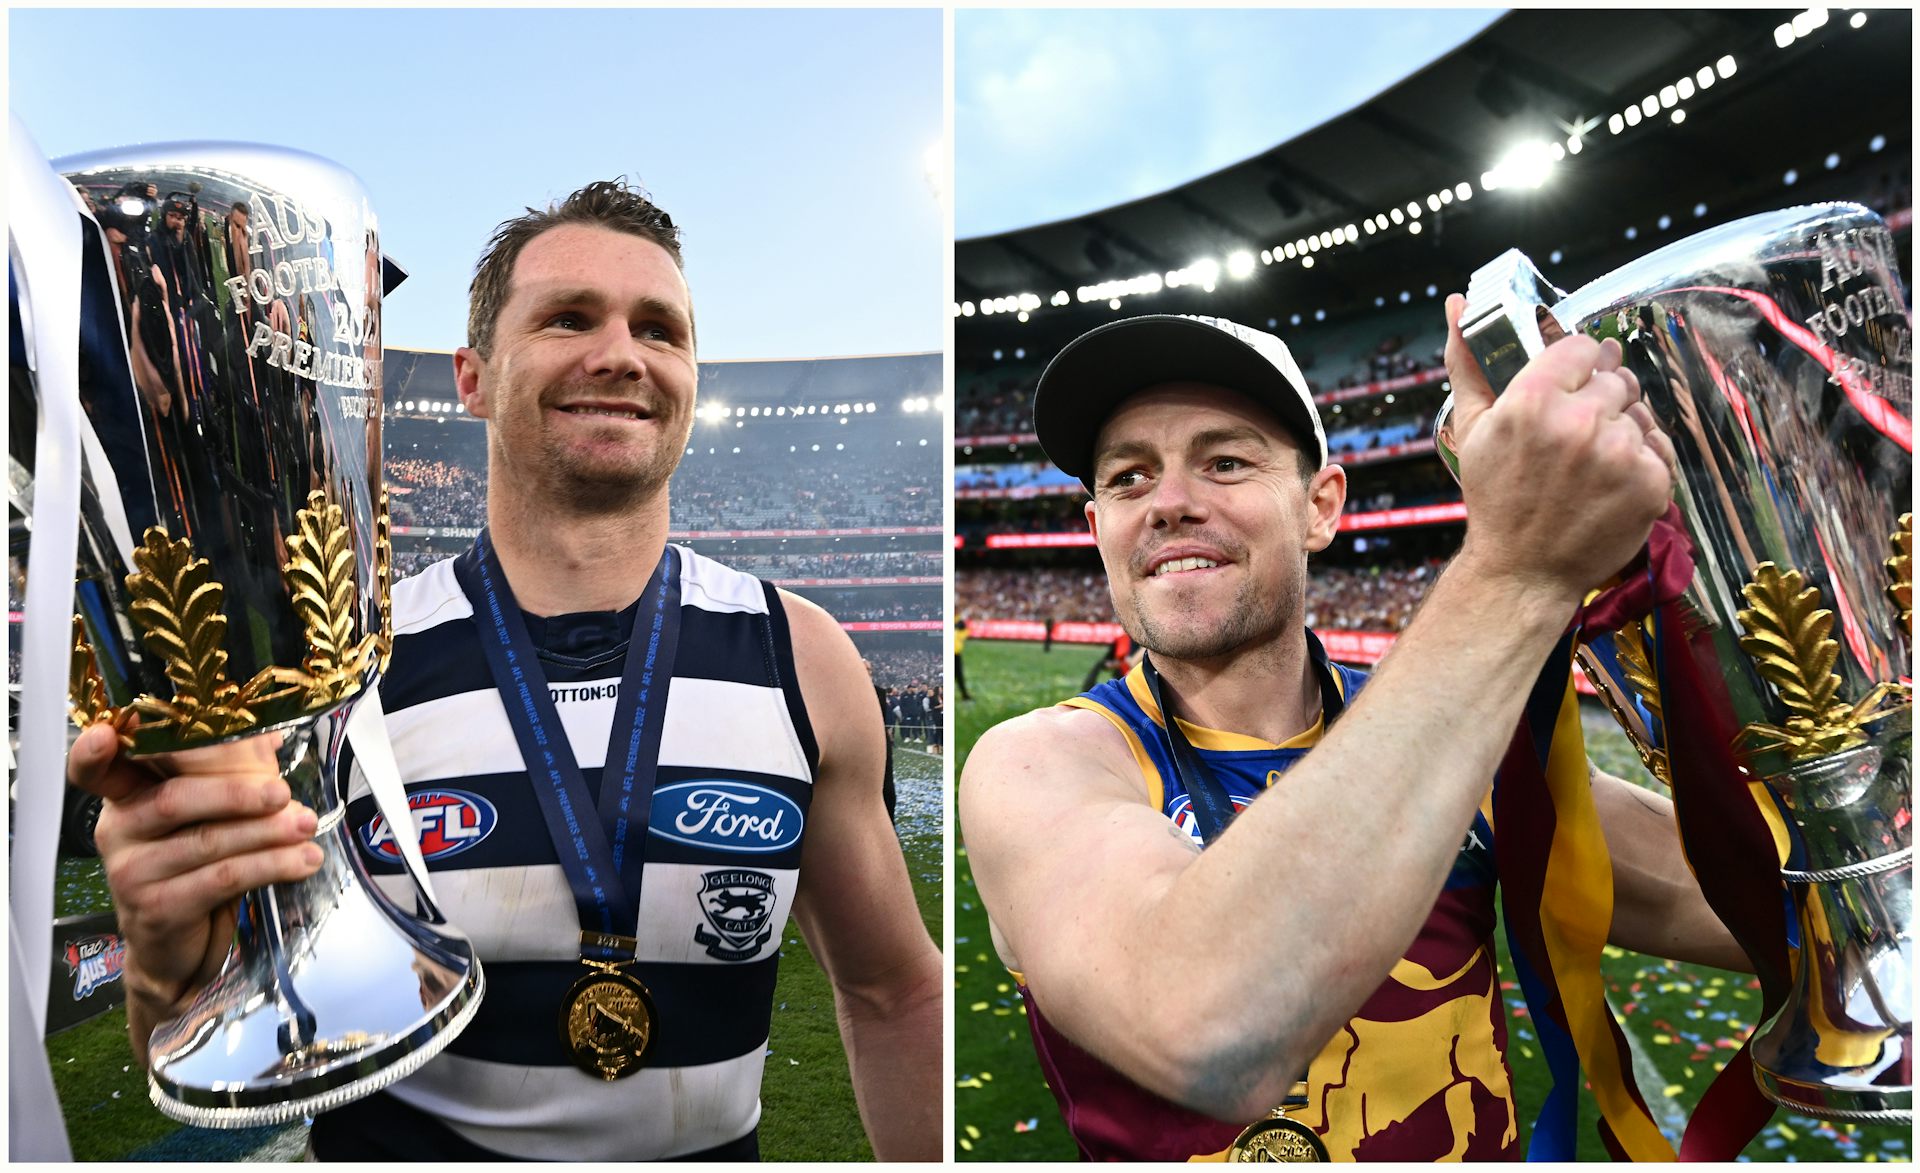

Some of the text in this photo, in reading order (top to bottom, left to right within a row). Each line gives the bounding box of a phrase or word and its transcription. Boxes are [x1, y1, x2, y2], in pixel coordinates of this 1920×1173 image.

[549, 682, 620, 703] OTTON:O
[675, 789, 784, 841] Ford
[710, 873, 770, 888] GEELONG
[725, 921, 756, 931] CATS
